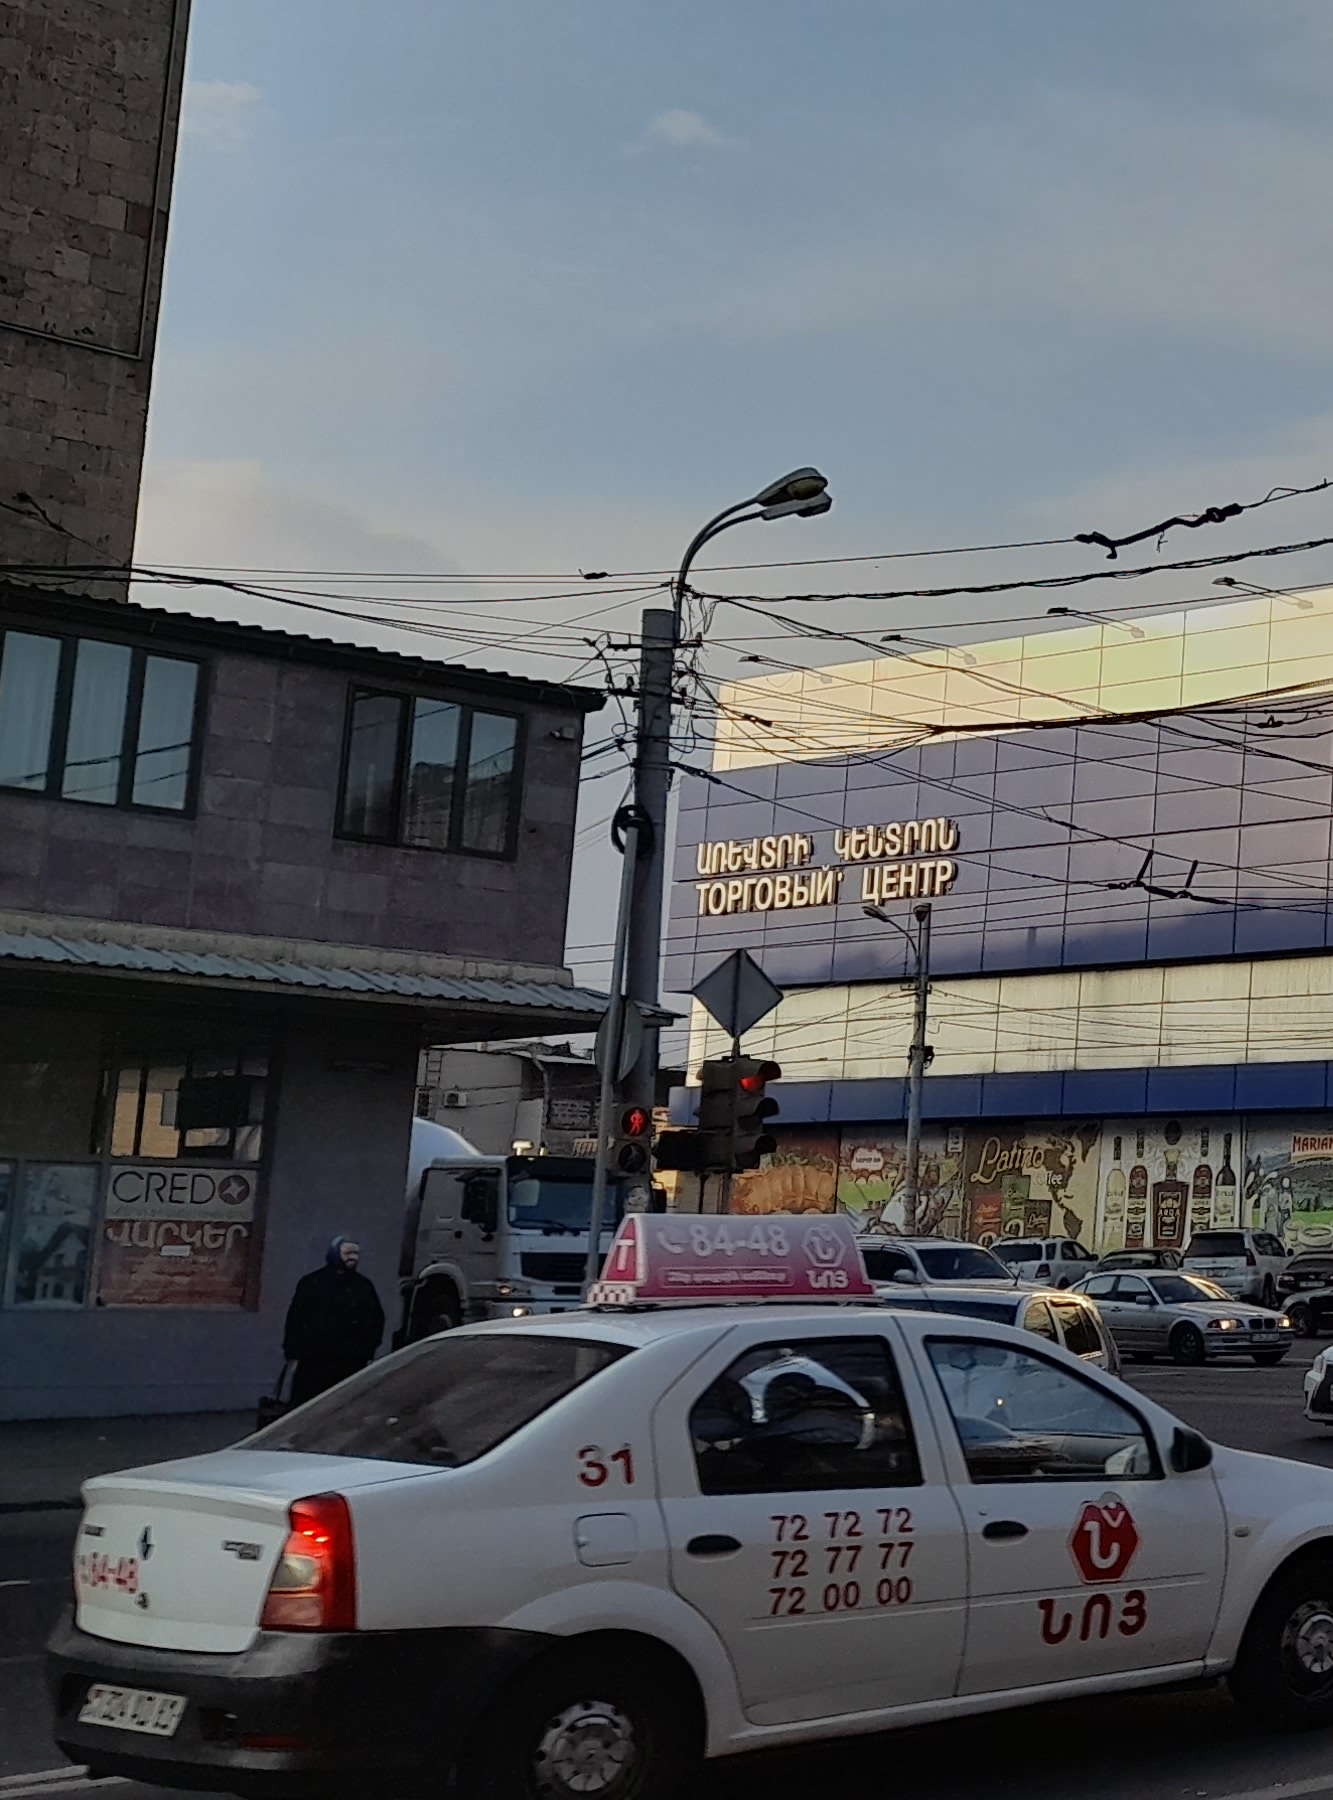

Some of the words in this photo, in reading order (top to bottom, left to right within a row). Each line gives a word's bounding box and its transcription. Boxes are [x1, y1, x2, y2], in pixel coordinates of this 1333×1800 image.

[697, 834, 811, 875] ԱՌԵՎՏՐԻ
[834, 817, 958, 861] ԿԵՆՏՐՈՆ
[696, 866, 836, 915] ТОРГОВЫЙ
[862, 860, 954, 905] ЦЕНТР
[970, 1136, 1045, 1184] Latino
[690, 1224, 790, 1258] 84-48
[579, 1447, 635, 1487] 31
[771, 1514, 809, 1542] 72
[825, 1511, 861, 1538] 72
[876, 1508, 914, 1534] 72
[772, 1550, 809, 1578] 72
[825, 1546, 861, 1573] 77
[878, 1542, 914, 1570] 77
[770, 1586, 806, 1615] 72
[824, 1581, 860, 1611] 00
[876, 1576, 913, 1606] 00
[1038, 1591, 1148, 1645] ՆՈՅ
